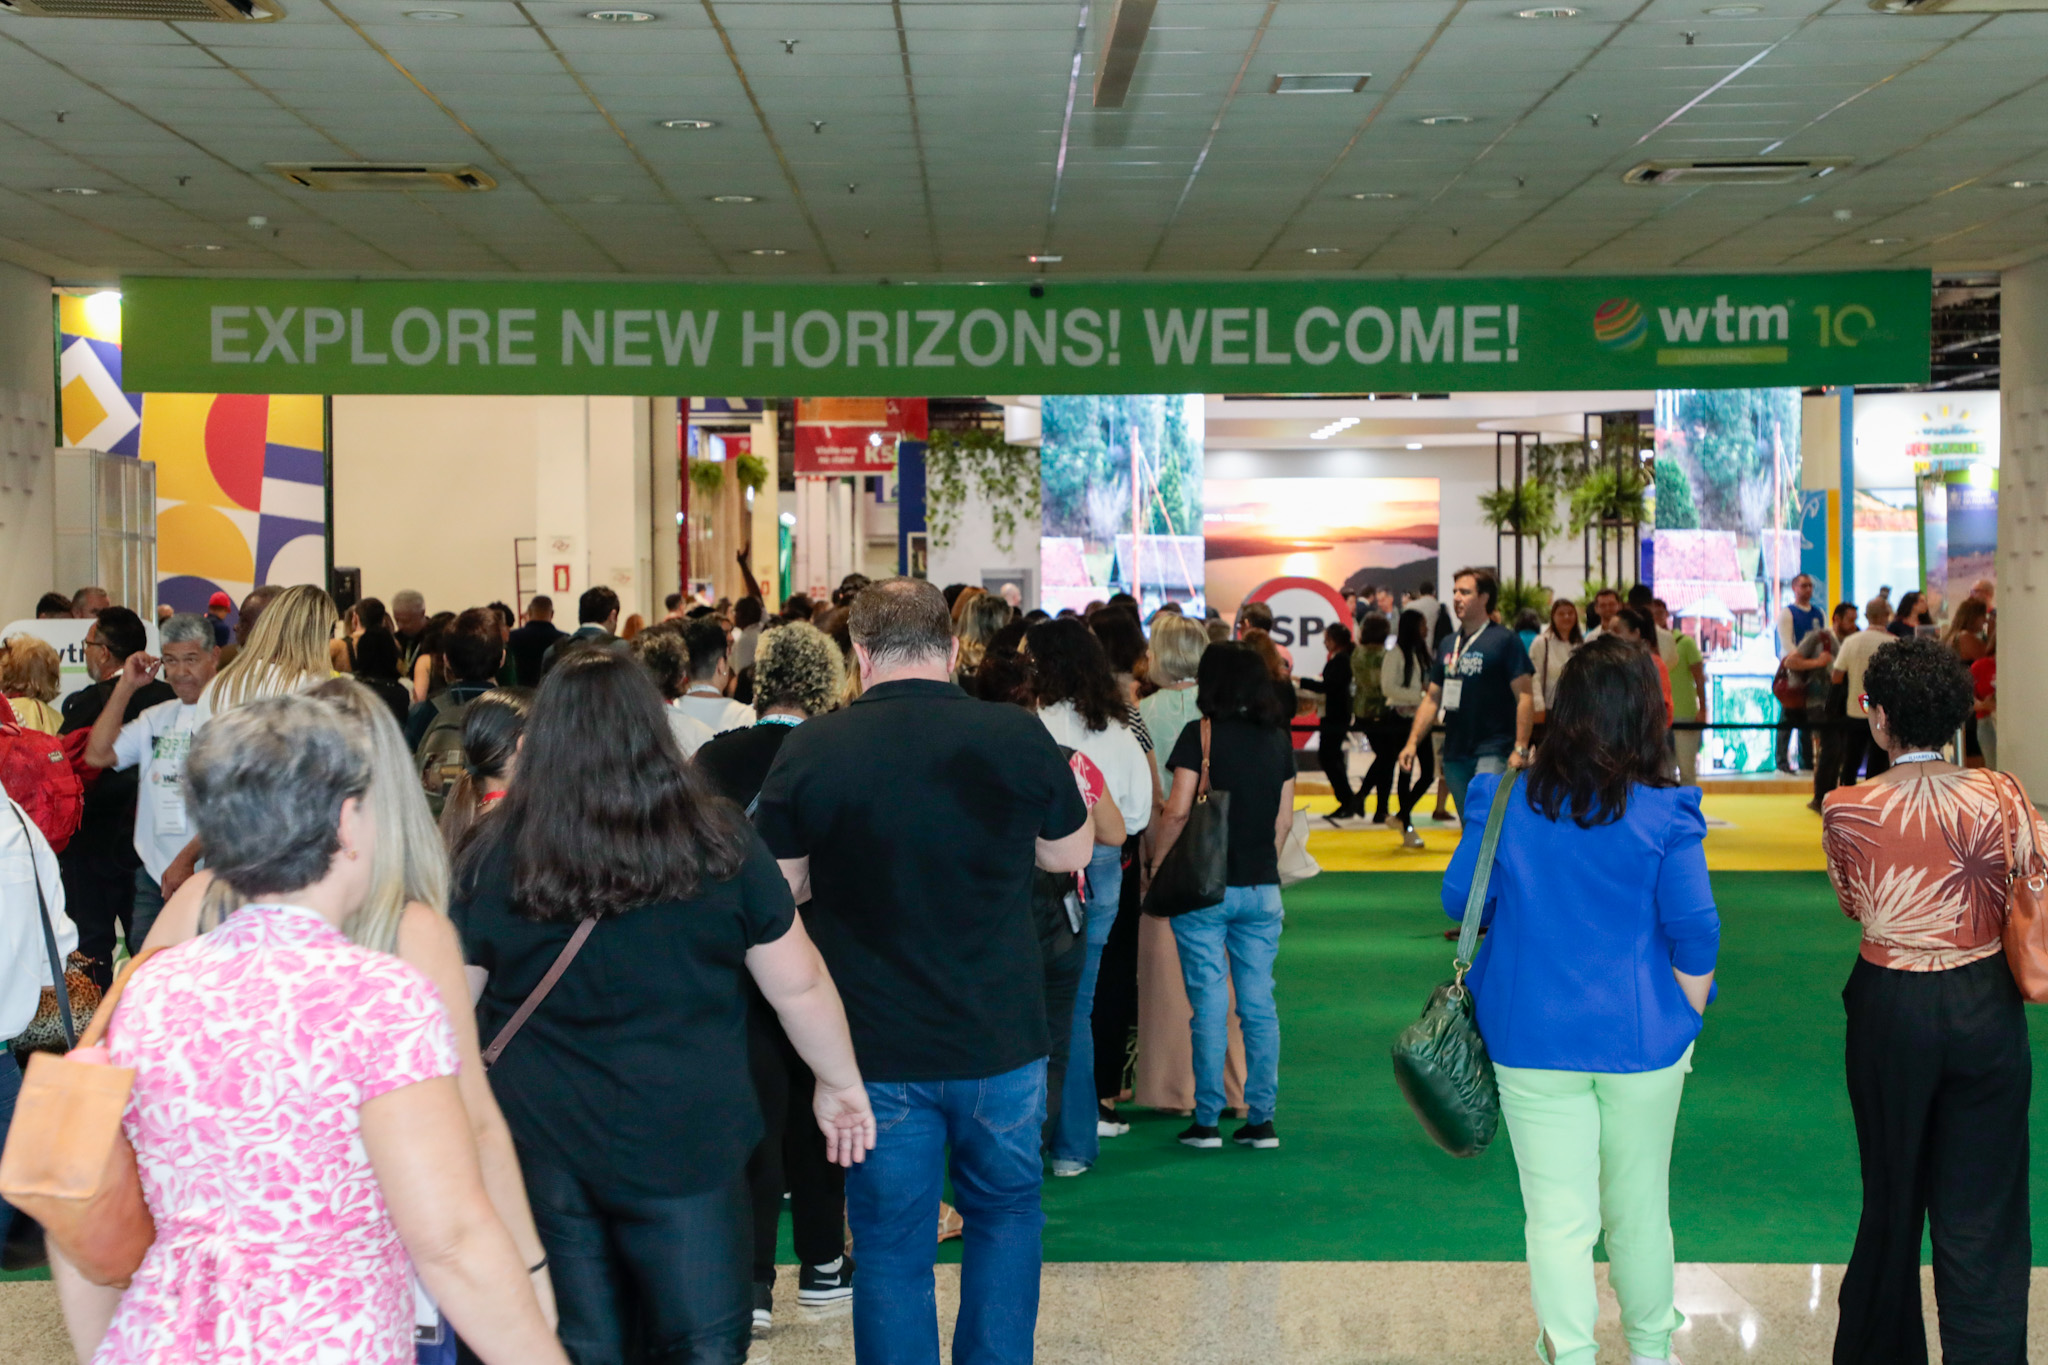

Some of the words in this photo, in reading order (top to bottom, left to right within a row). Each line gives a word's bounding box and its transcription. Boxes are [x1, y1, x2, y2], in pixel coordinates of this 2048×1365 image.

[210, 306, 537, 366] EXPLORE
[562, 309, 720, 367] NEW
[742, 308, 1121, 369] HORIZONS!
[1143, 305, 1520, 366] WELCOME!
[1657, 294, 1789, 342] wtm
[1813, 304, 1877, 347] 10
[1271, 616, 1325, 648] SP
